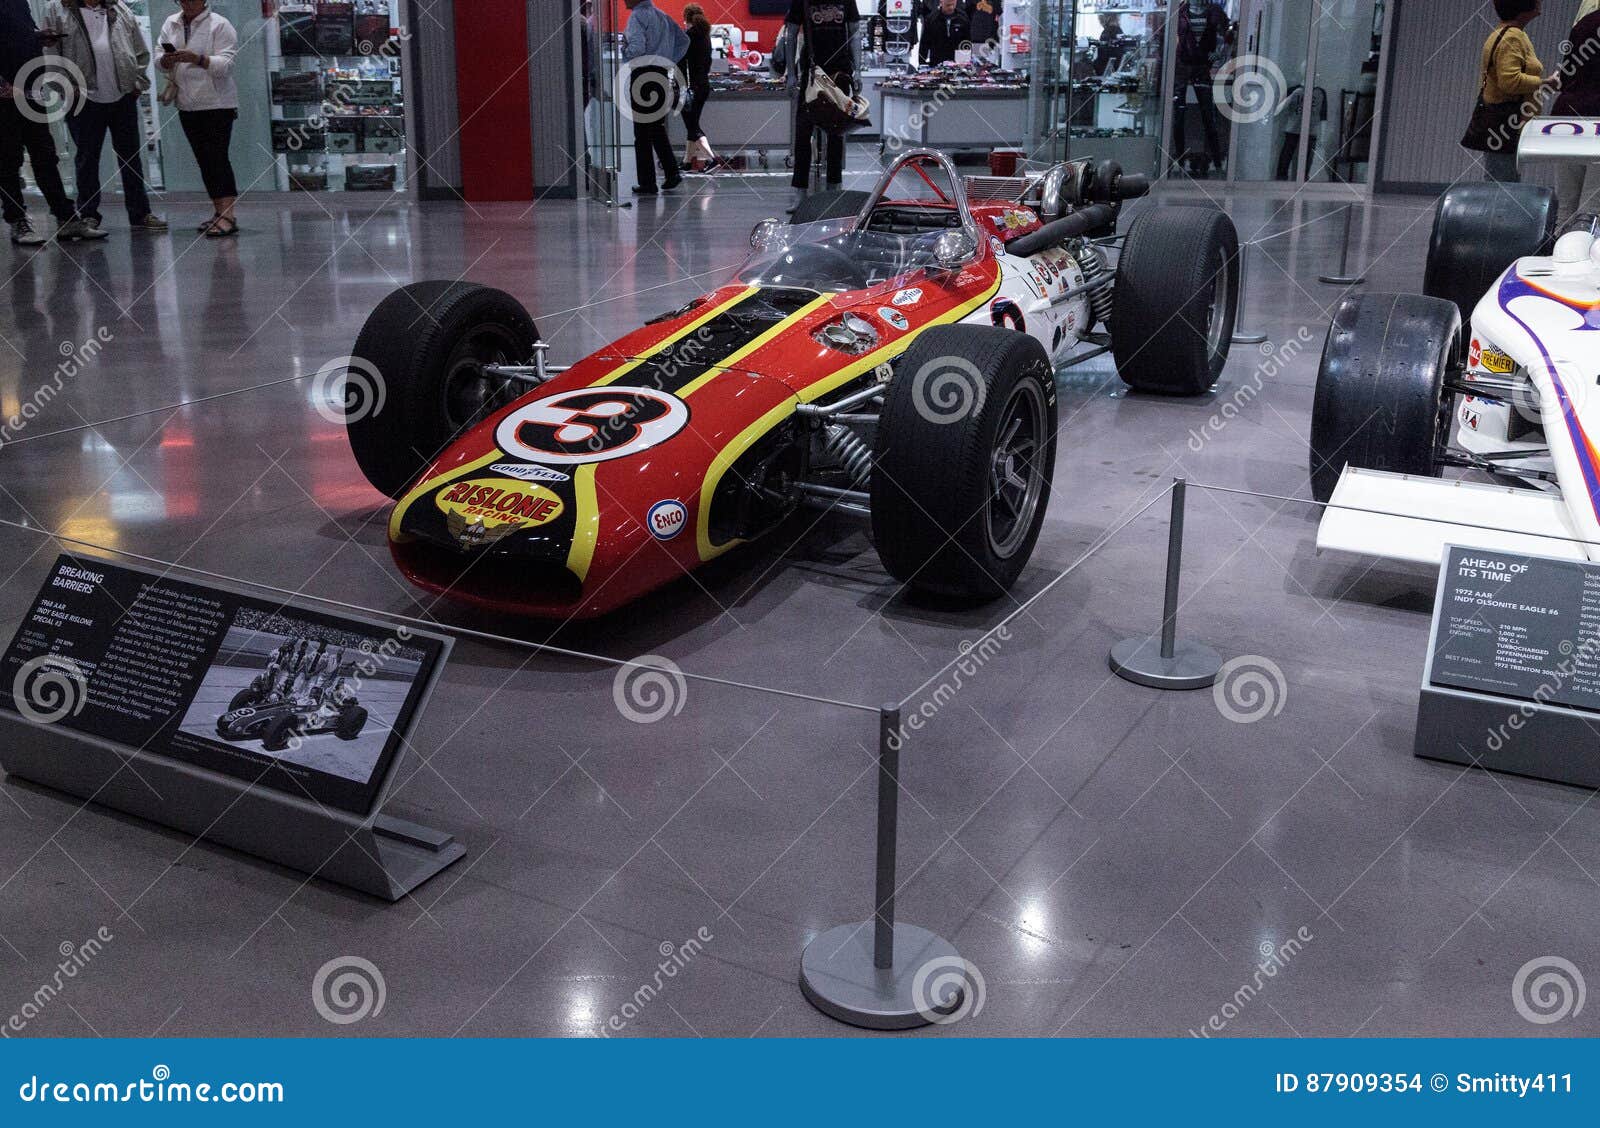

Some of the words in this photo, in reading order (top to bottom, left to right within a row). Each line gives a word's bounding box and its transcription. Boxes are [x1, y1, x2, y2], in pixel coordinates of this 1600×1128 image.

[1483, 352, 1511, 371] PREMIER
[513, 391, 671, 456] 3
[491, 464, 567, 481] GOODYEAR
[443, 481, 560, 522] RISLONE
[463, 506, 520, 523] RACING
[654, 510, 682, 529] ENCO
[1460, 557, 1506, 571] AHEAD
[1509, 564, 1529, 573] OF
[58, 565, 105, 584] BREAKING
[1459, 567, 1477, 578] ITS
[1481, 570, 1512, 582] TIME
[52, 576, 95, 594] BARRIERS
[1455, 588, 1473, 596] 1972
[1474, 591, 1493, 599] AAR
[1454, 595, 1474, 603] INDY
[1476, 598, 1517, 610] OLSONITE
[1519, 604, 1546, 614] EAGLE
[1548, 608, 1559, 616] #6
[1510, 664, 1541, 674] TRENTON
